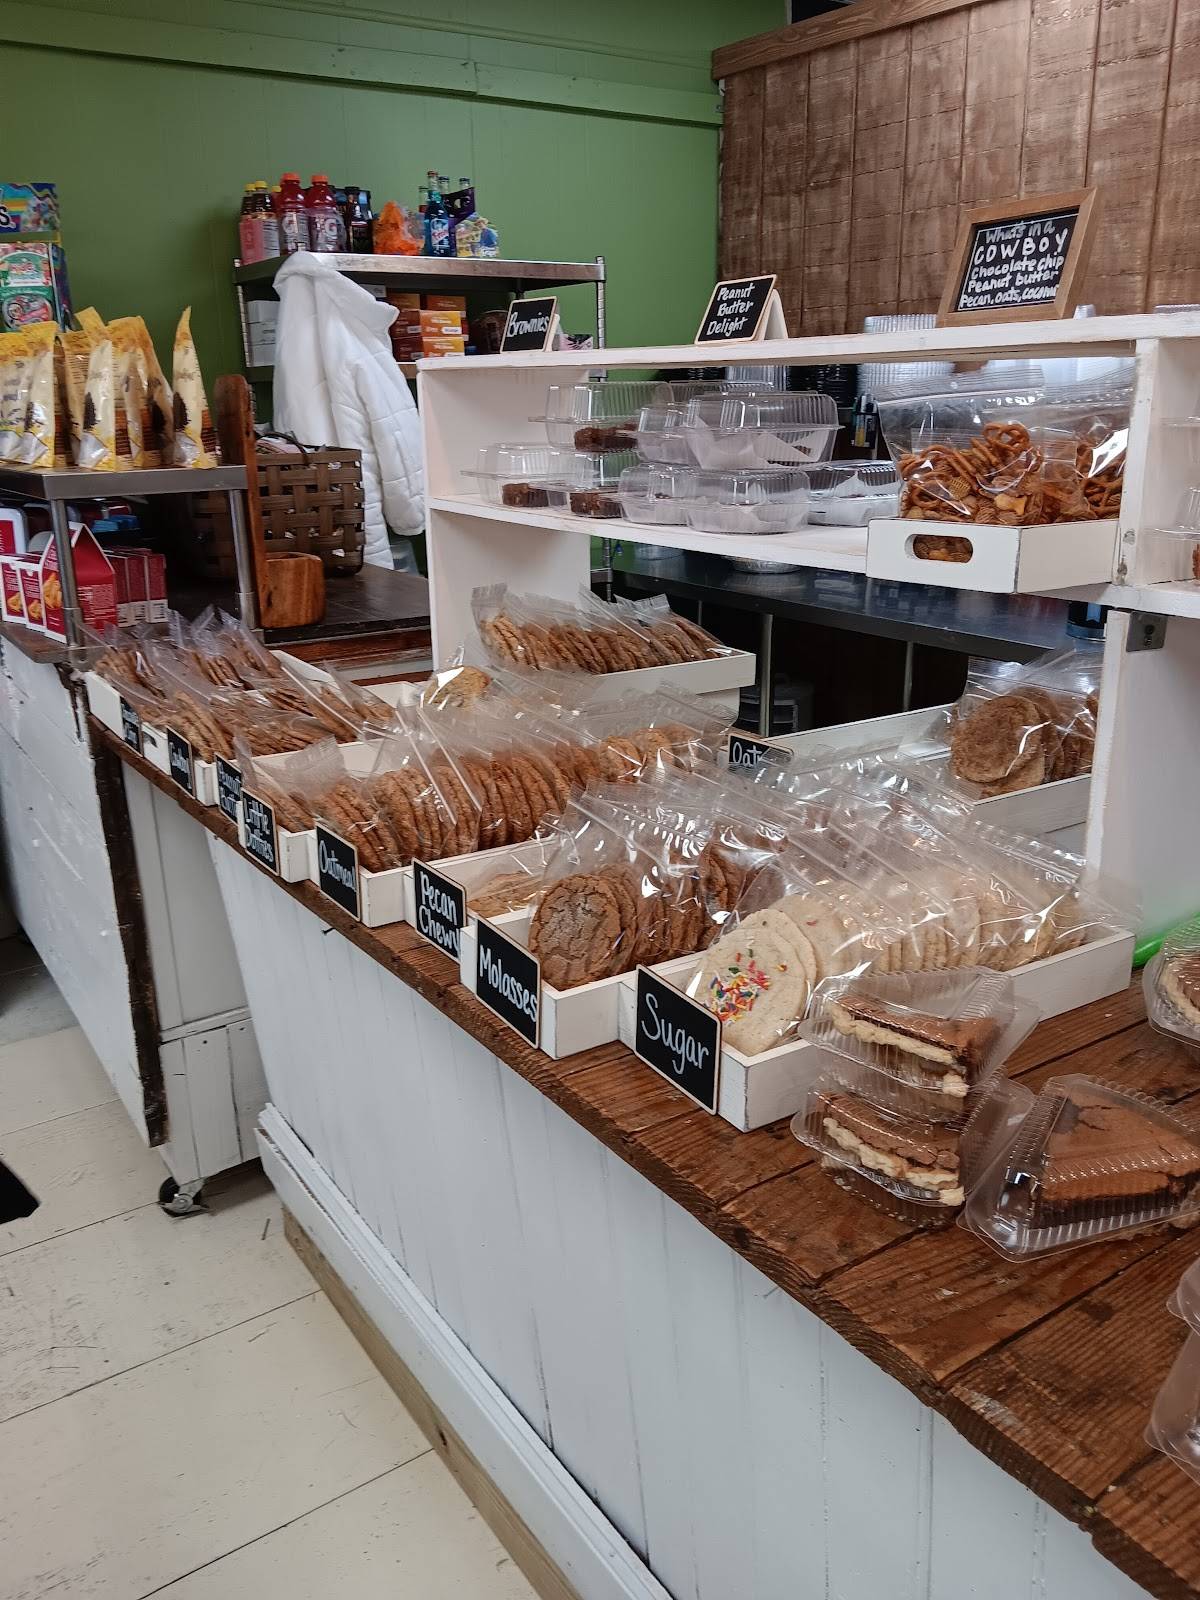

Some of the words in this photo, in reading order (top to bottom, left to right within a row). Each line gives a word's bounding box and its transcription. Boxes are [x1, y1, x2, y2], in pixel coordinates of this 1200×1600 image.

[1028, 221, 1042, 236] in
[1043, 220, 1056, 234] a
[974, 228, 1068, 265] COWBOY
[717, 282, 756, 301] Peanut
[968, 274, 1013, 293] Peanut
[1015, 269, 1059, 287] butter
[717, 300, 754, 317] Butter
[506, 311, 550, 338] Brownies
[706, 316, 749, 337] Delight
[732, 741, 763, 768] Oat
[318, 839, 357, 893] Oatmeal
[420, 870, 458, 926] Pecan
[418, 904, 462, 961] Chewy
[479, 944, 538, 1023] Molasses
[640, 992, 710, 1075] Sugar
